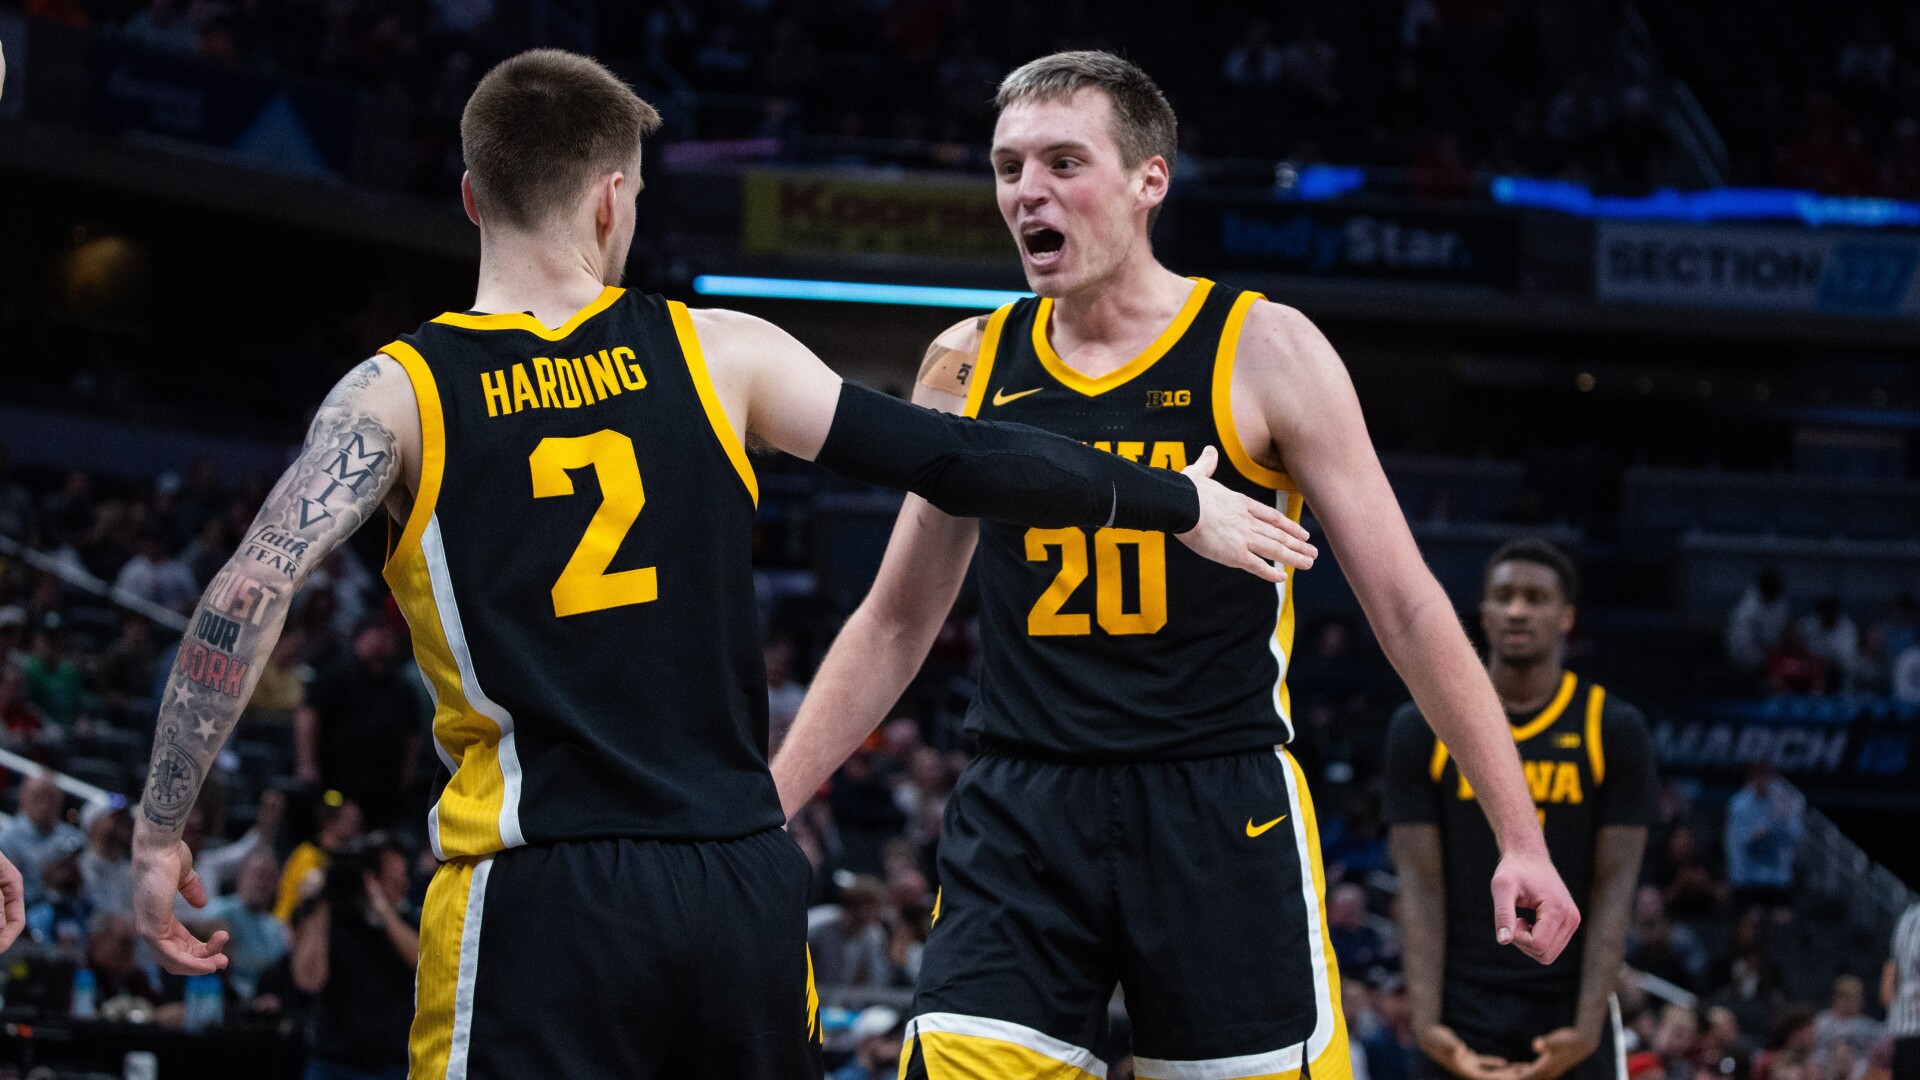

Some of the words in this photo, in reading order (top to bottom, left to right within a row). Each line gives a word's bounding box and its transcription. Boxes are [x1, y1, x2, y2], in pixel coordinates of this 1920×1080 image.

[1608, 241, 1821, 289] SECTION
[480, 346, 648, 418] HARDING
[249, 524, 310, 560] faith
[528, 428, 659, 618] 2
[243, 544, 300, 581] FEAR
[1024, 526, 1167, 637] 20
[1653, 718, 1849, 773] MARCH
